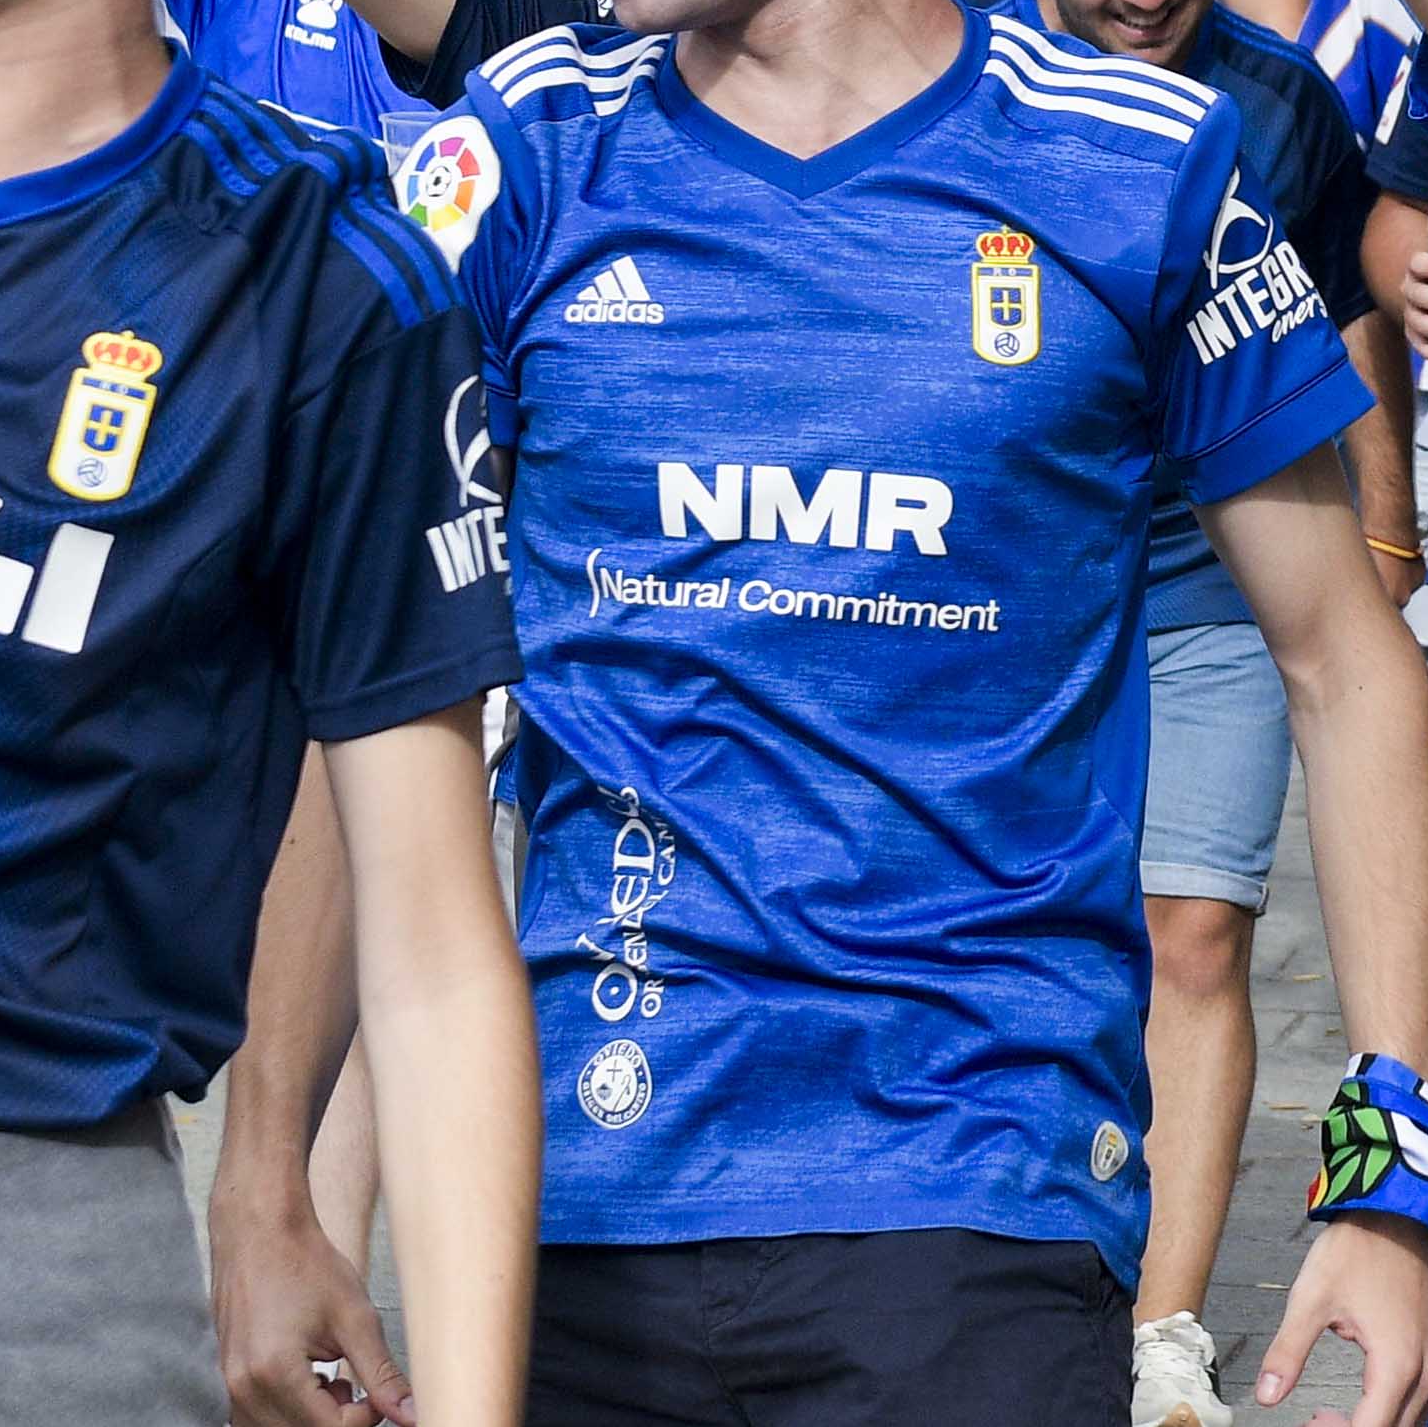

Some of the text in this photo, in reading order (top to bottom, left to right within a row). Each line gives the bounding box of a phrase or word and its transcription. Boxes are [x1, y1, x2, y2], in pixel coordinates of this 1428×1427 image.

[563, 298, 665, 325] adidas
[1185, 240, 1315, 366] INTEGR
[425, 505, 511, 593] INTE
[658, 461, 954, 556] NMR
[599, 566, 1001, 632] Natural Commitment
